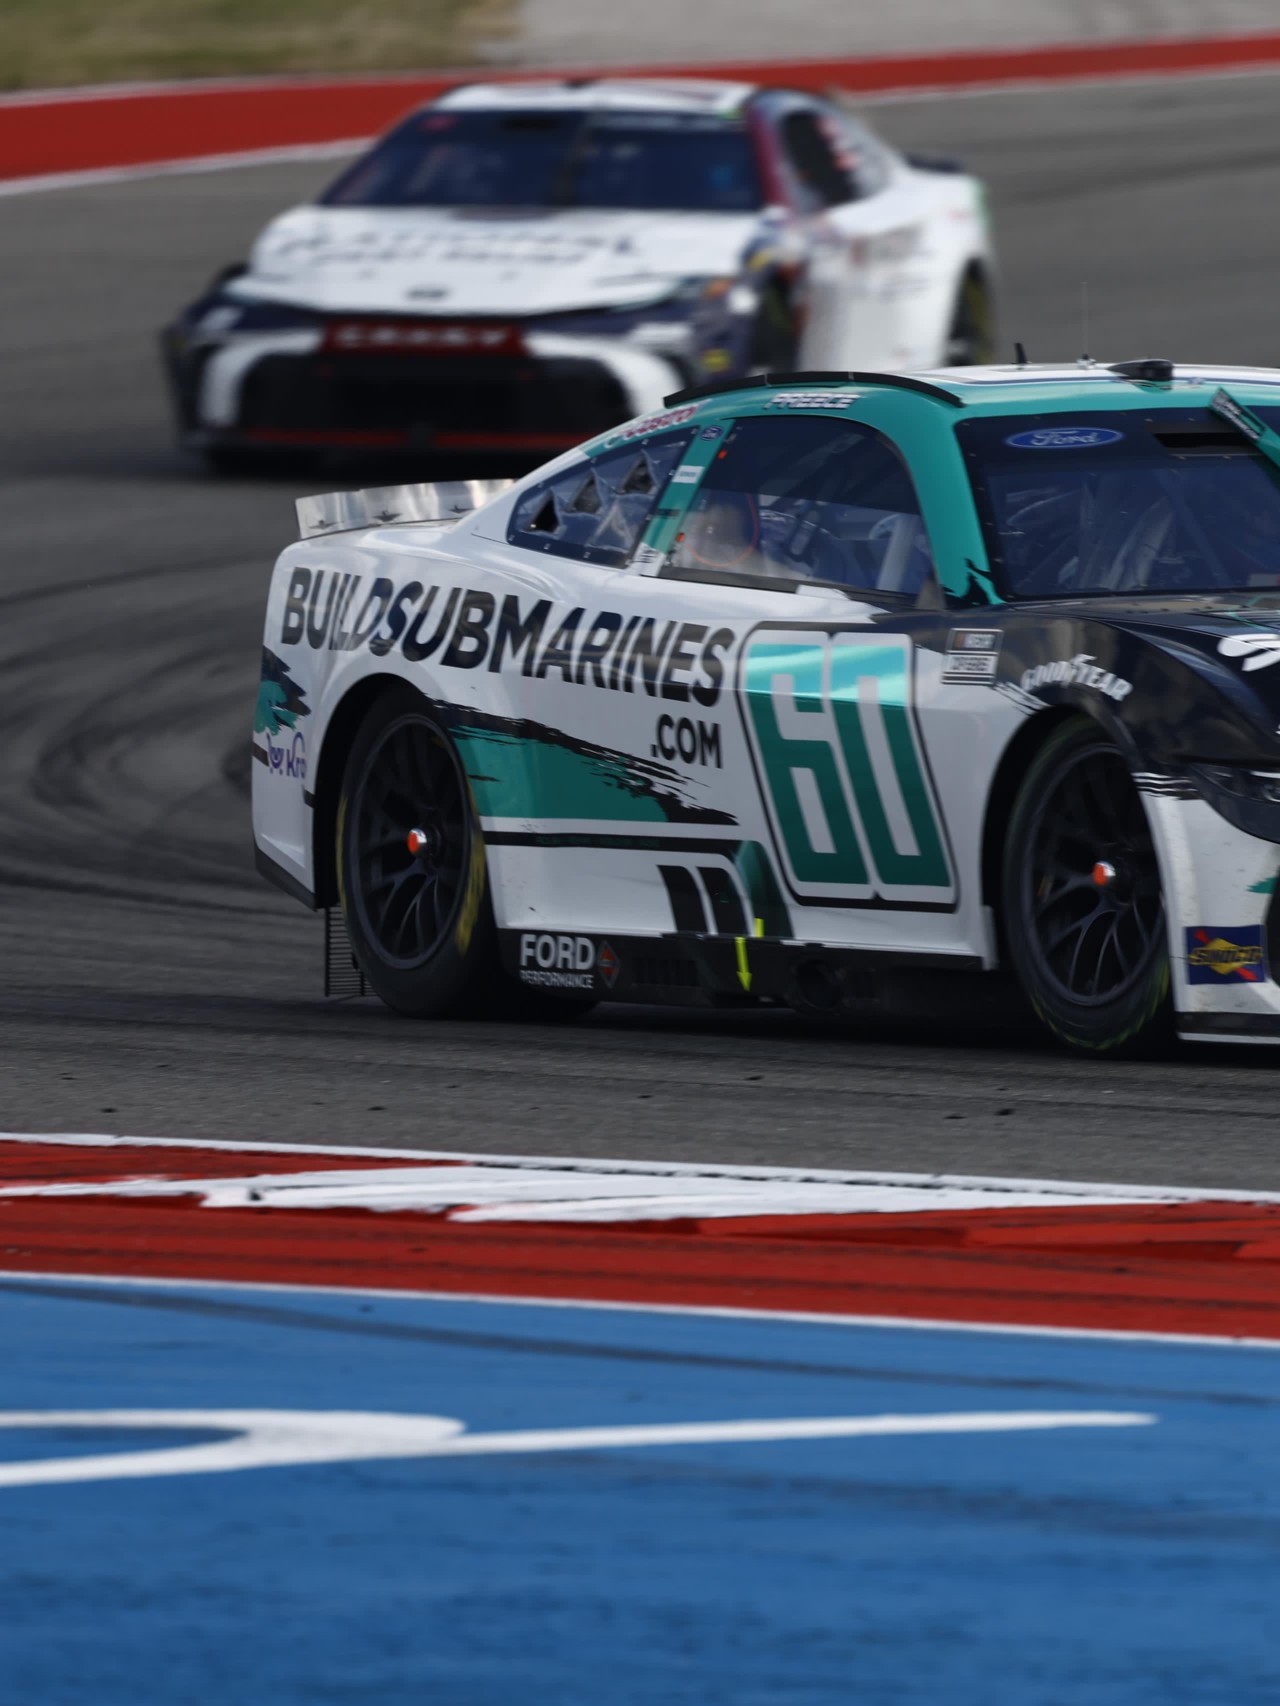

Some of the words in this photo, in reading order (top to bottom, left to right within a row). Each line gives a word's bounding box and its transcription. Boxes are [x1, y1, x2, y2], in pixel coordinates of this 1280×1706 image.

[762, 392, 862, 410] PREECE
[281, 566, 736, 708] BUILDSUBMARINES
[1020, 653, 1134, 701] GOODYEAR
[652, 713, 723, 769] .COM
[740, 631, 956, 899] 60
[520, 933, 596, 970] FORD
[519, 969, 594, 989] PERFORMANCE
